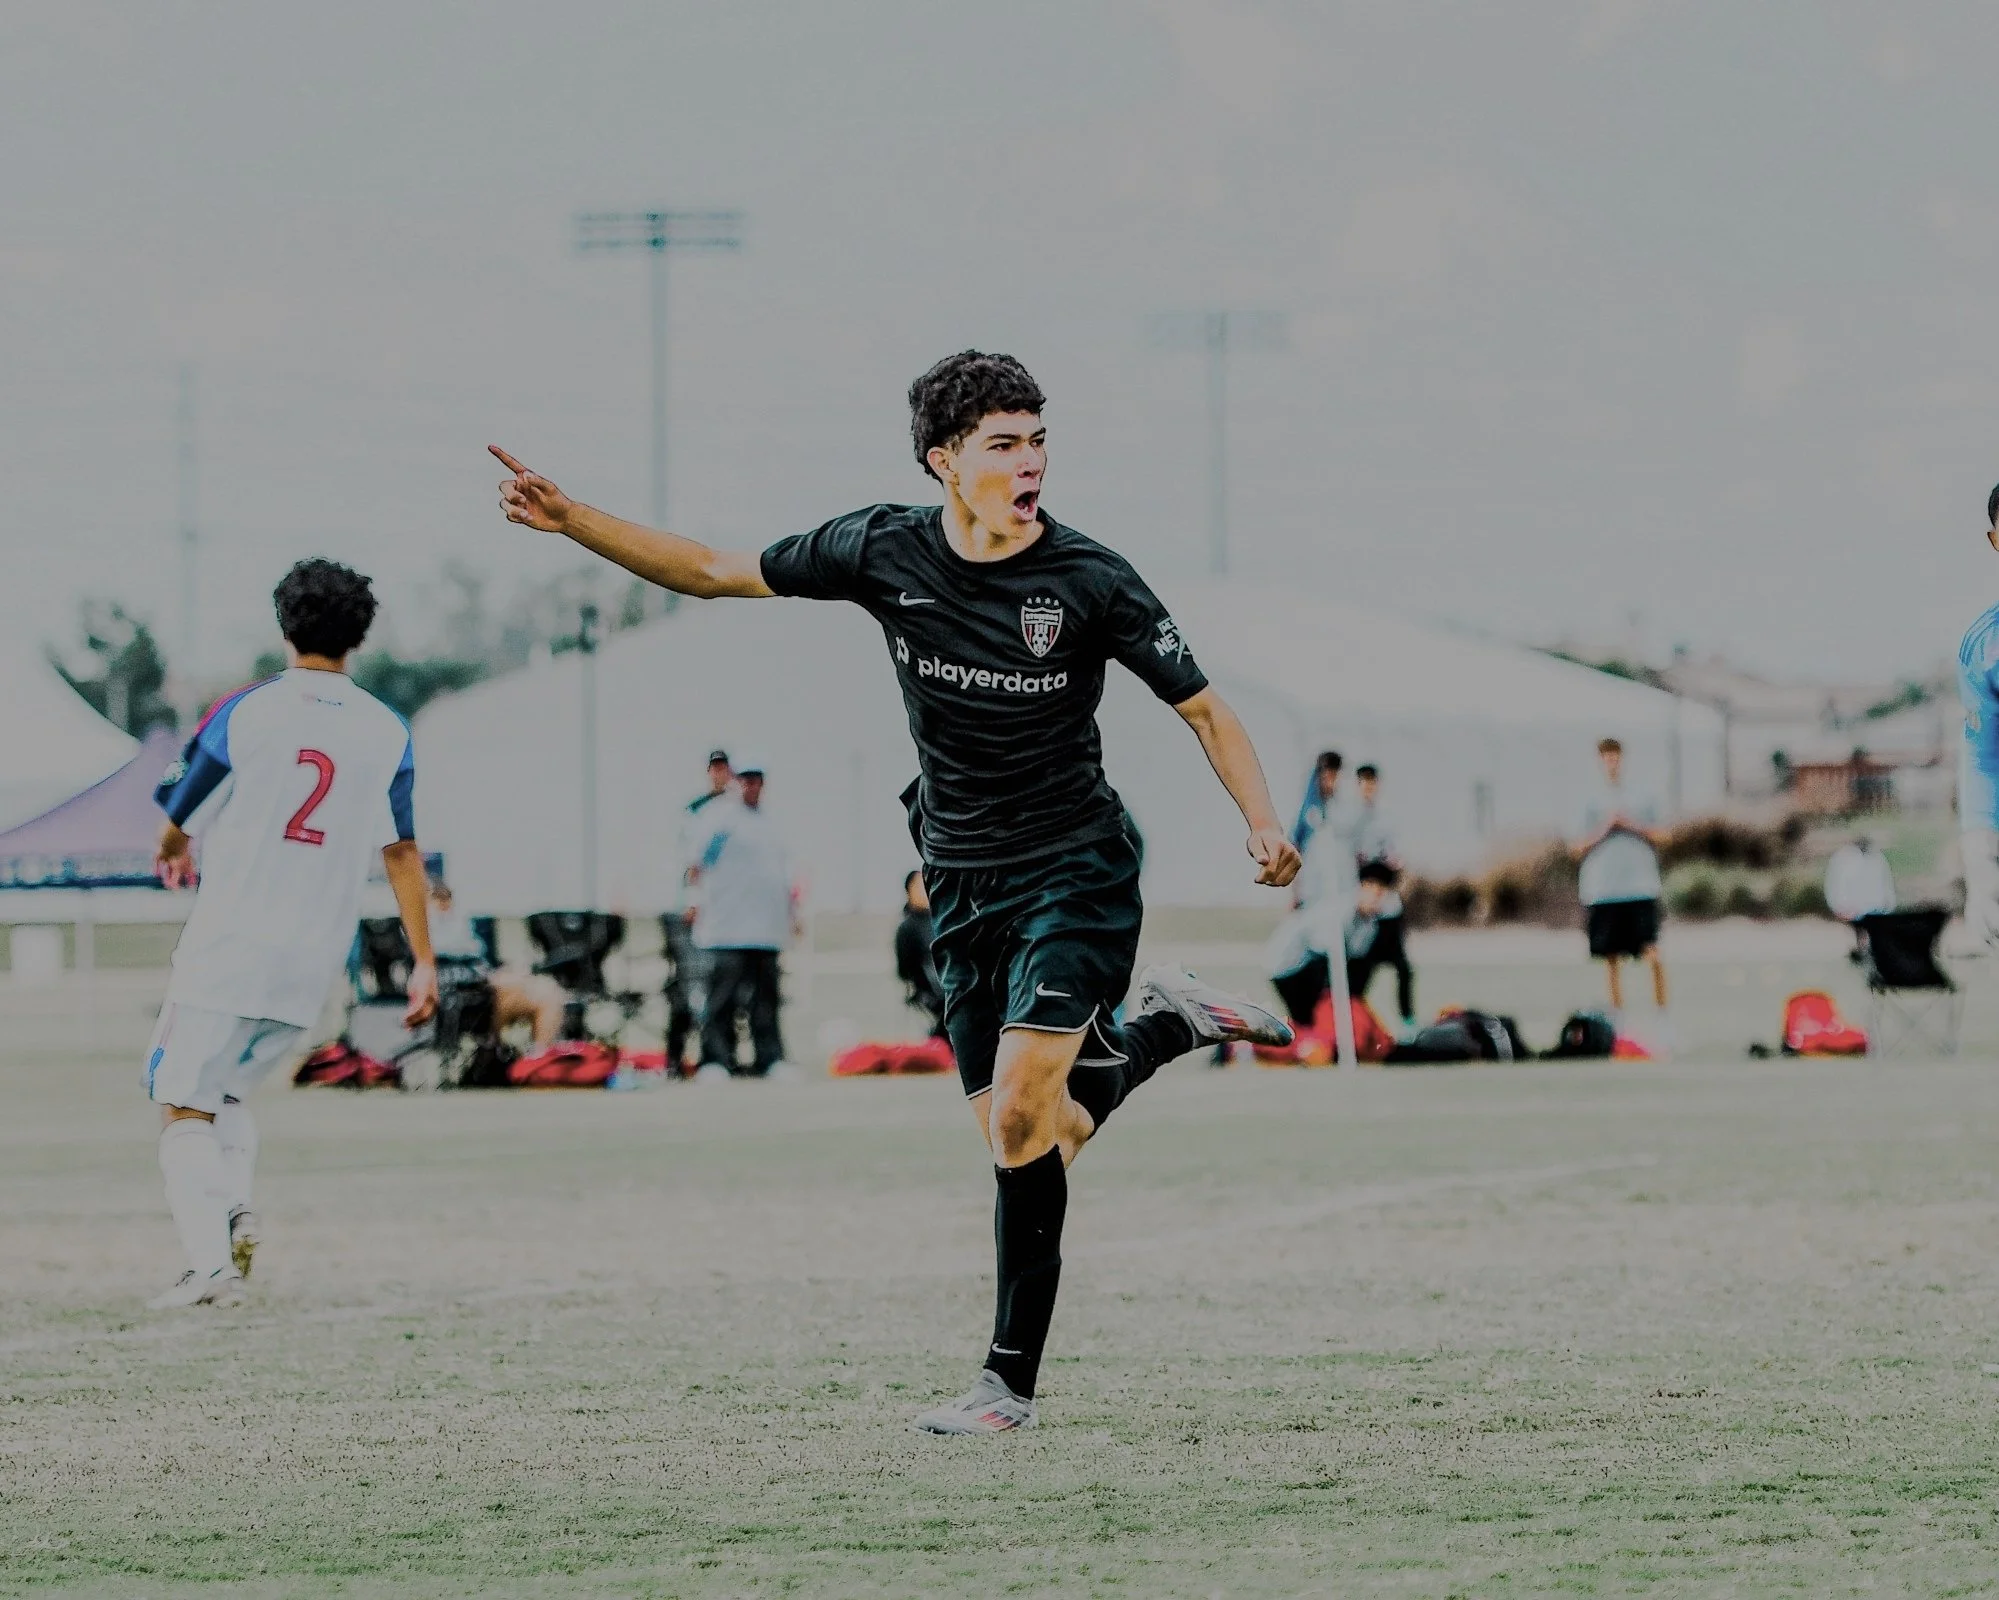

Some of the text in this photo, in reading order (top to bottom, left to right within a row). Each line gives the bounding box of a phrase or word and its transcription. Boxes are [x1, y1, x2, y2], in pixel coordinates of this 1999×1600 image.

[1153, 628, 1191, 664] NEX
[918, 656, 1068, 694] playerdata
[284, 749, 335, 845] 2
